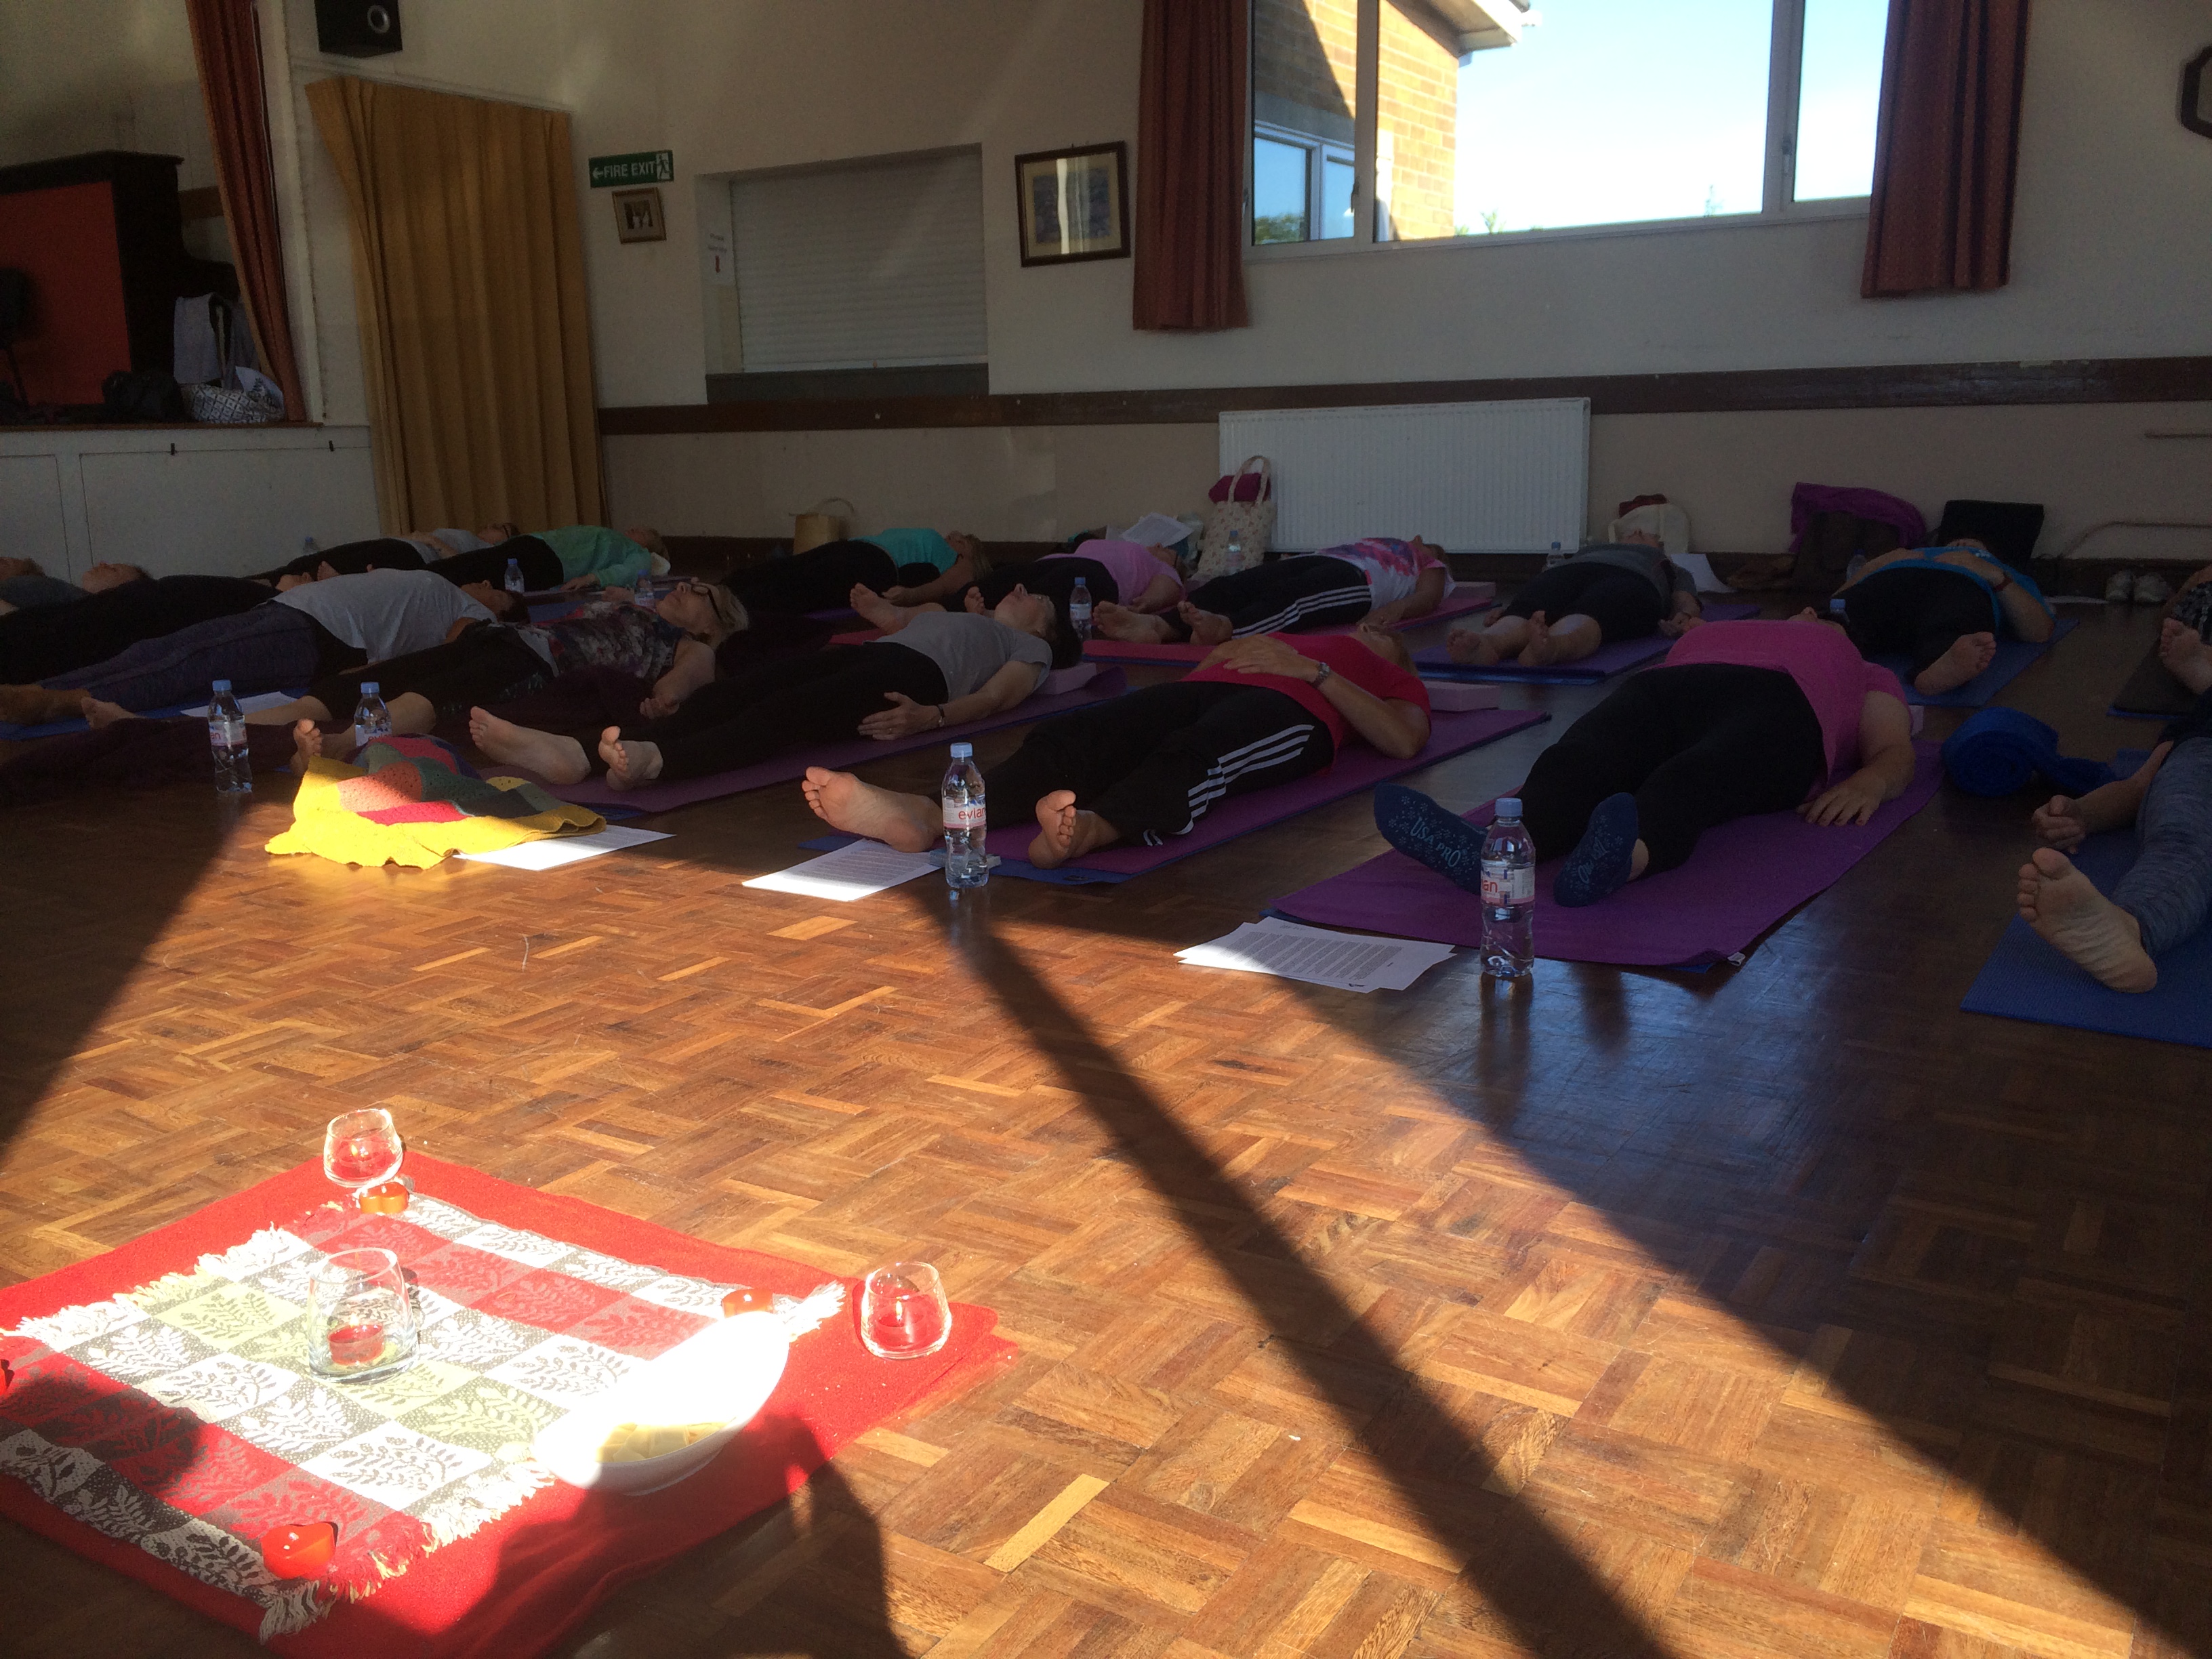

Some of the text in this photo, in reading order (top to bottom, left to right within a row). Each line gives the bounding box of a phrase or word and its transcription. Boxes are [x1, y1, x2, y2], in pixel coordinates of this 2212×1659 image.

[604, 161, 655, 178] FIRE EXIT
[1410, 816, 1434, 845] USA
